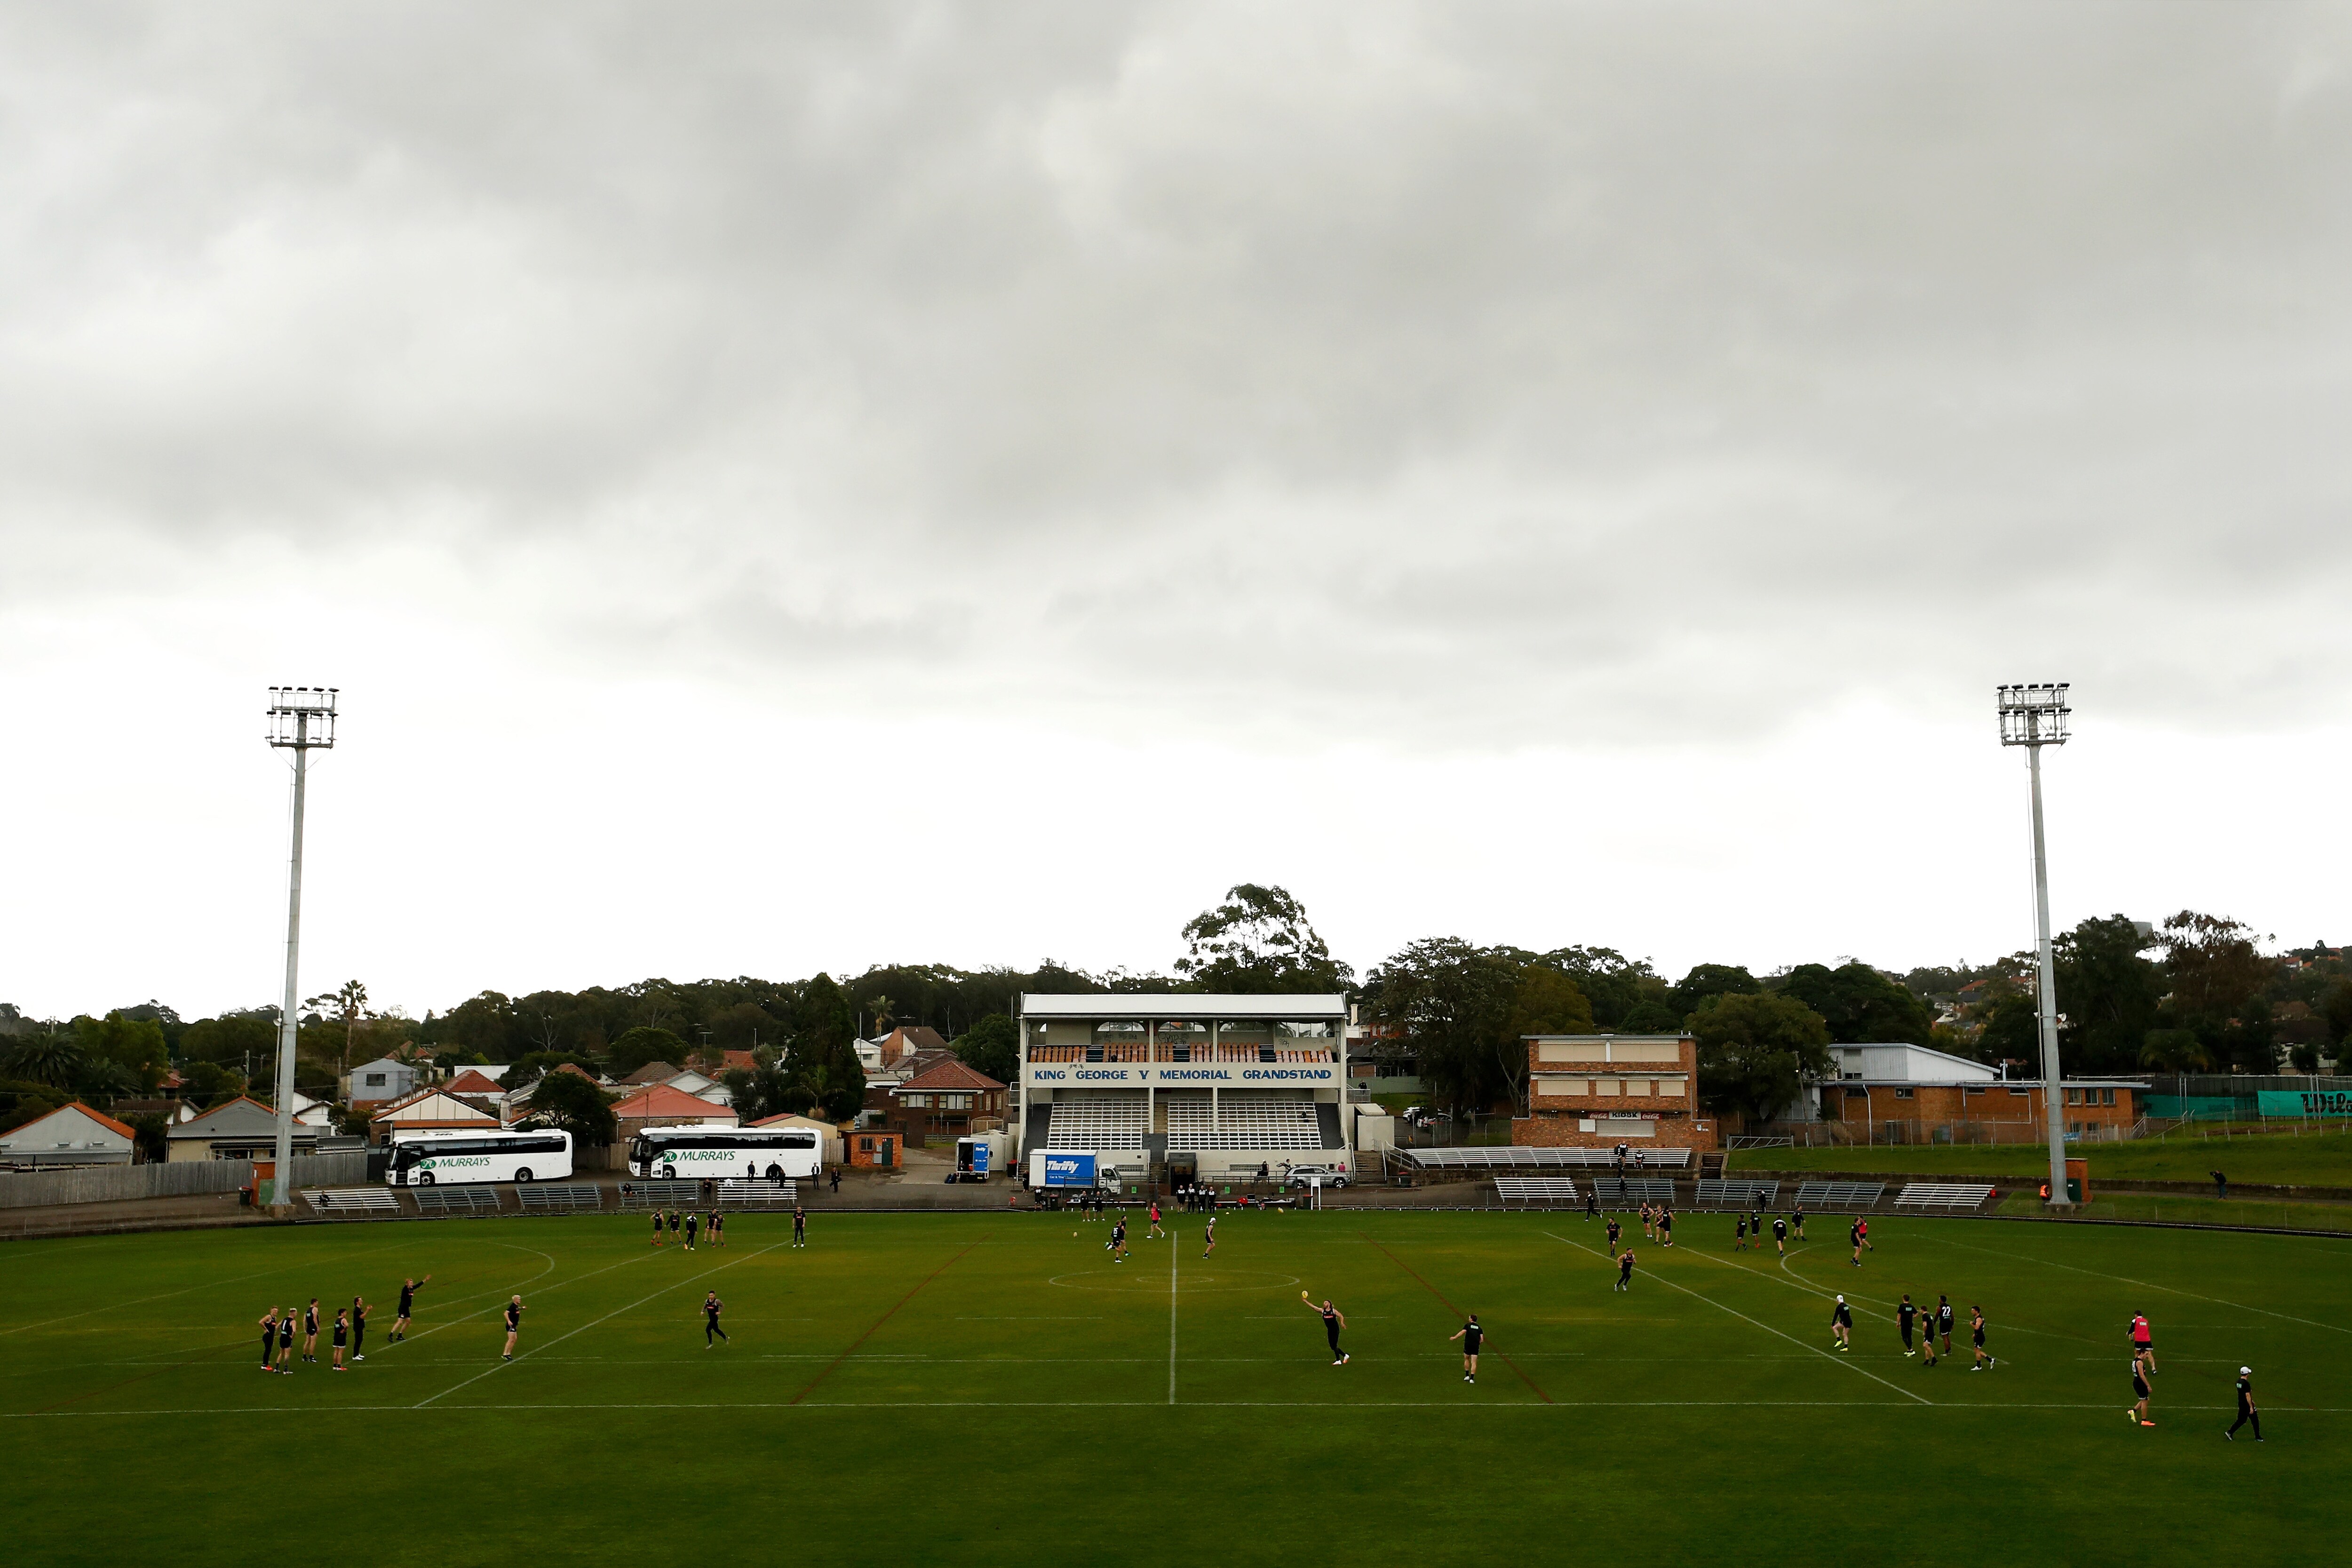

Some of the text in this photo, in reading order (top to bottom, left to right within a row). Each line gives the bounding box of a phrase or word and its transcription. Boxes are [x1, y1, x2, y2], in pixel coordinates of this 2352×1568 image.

[1035, 1070, 1332, 1080] KING GEORGE V MEMORIAL GRANDSTAND
[679, 1151, 736, 1161] MURRAYS
[439, 1157, 491, 1168] MURRAYS
[1047, 1160, 1079, 1174] Thrifty
[1942, 1306, 1951, 1317] 22
[282, 1319, 287, 1330] 1
